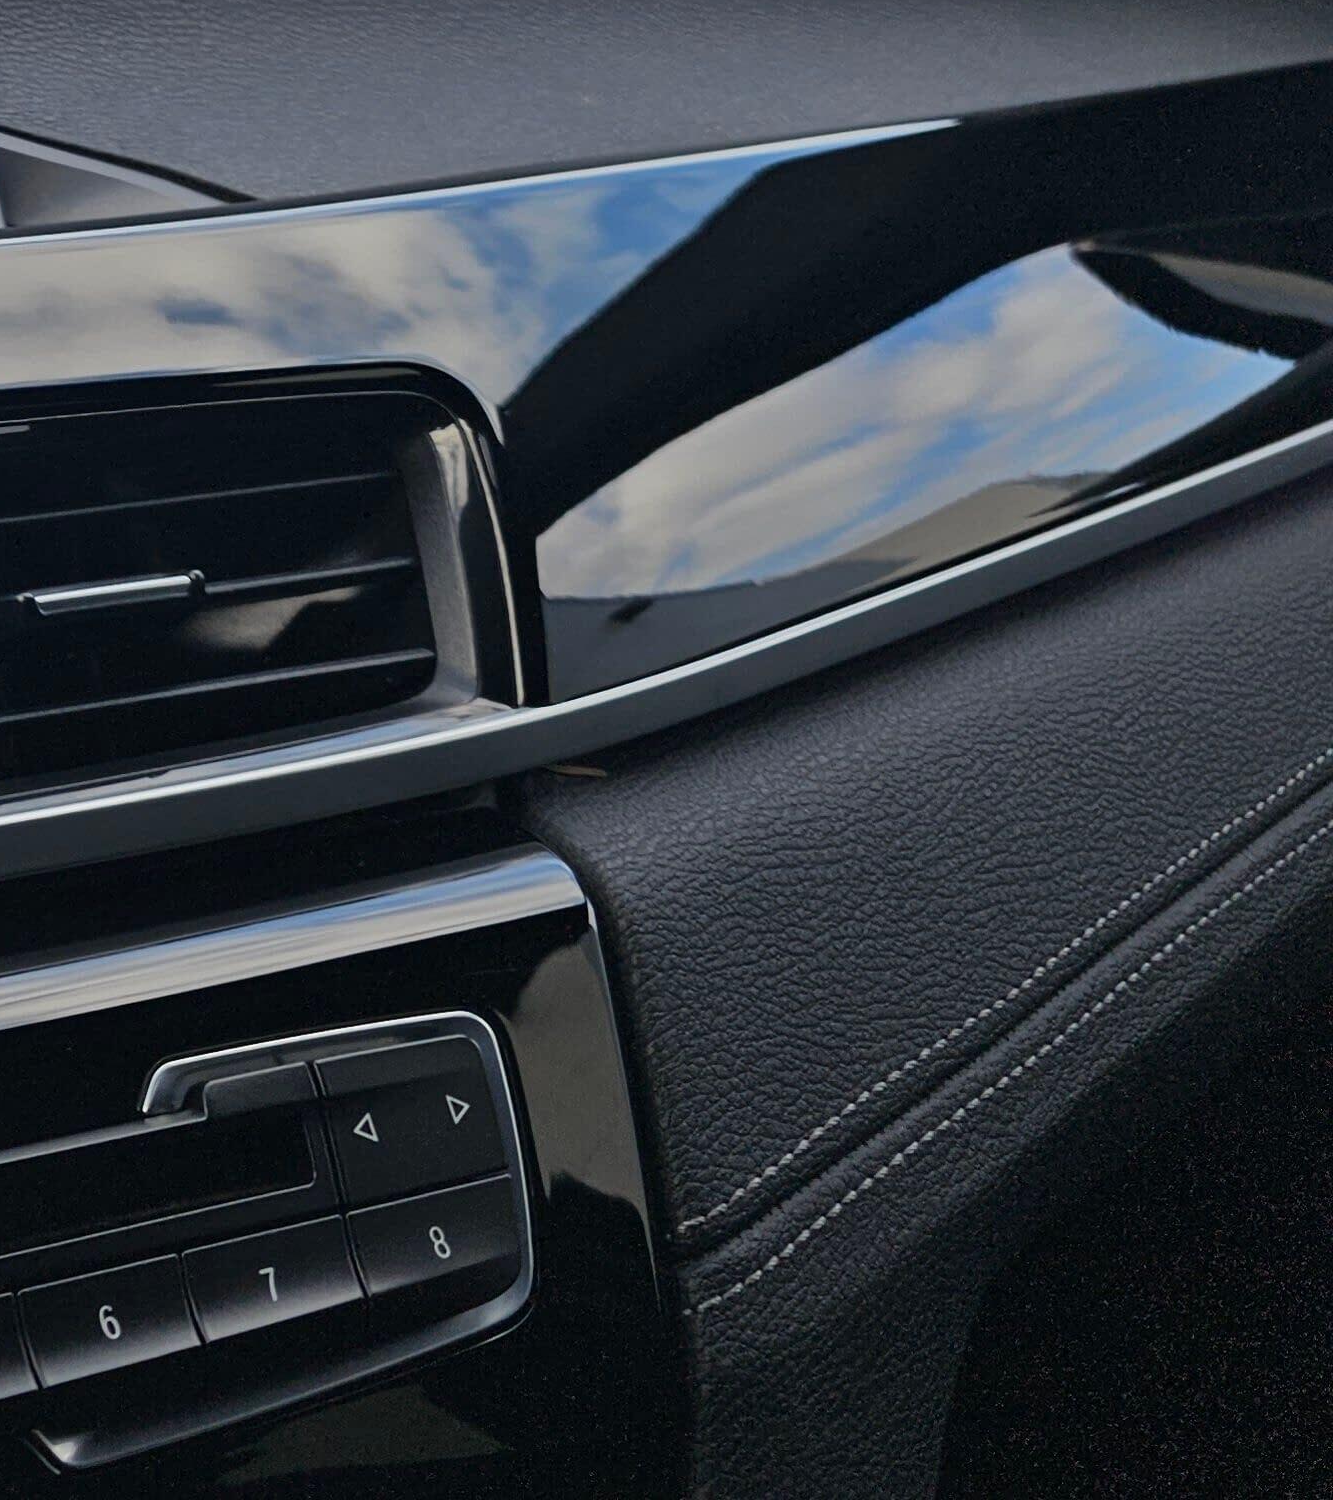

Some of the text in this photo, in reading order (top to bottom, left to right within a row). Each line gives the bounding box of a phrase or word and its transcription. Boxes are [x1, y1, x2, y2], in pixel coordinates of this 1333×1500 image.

[428, 1225, 452, 1260] 8
[257, 1266, 279, 1302] 7
[97, 1304, 123, 1341] 6
